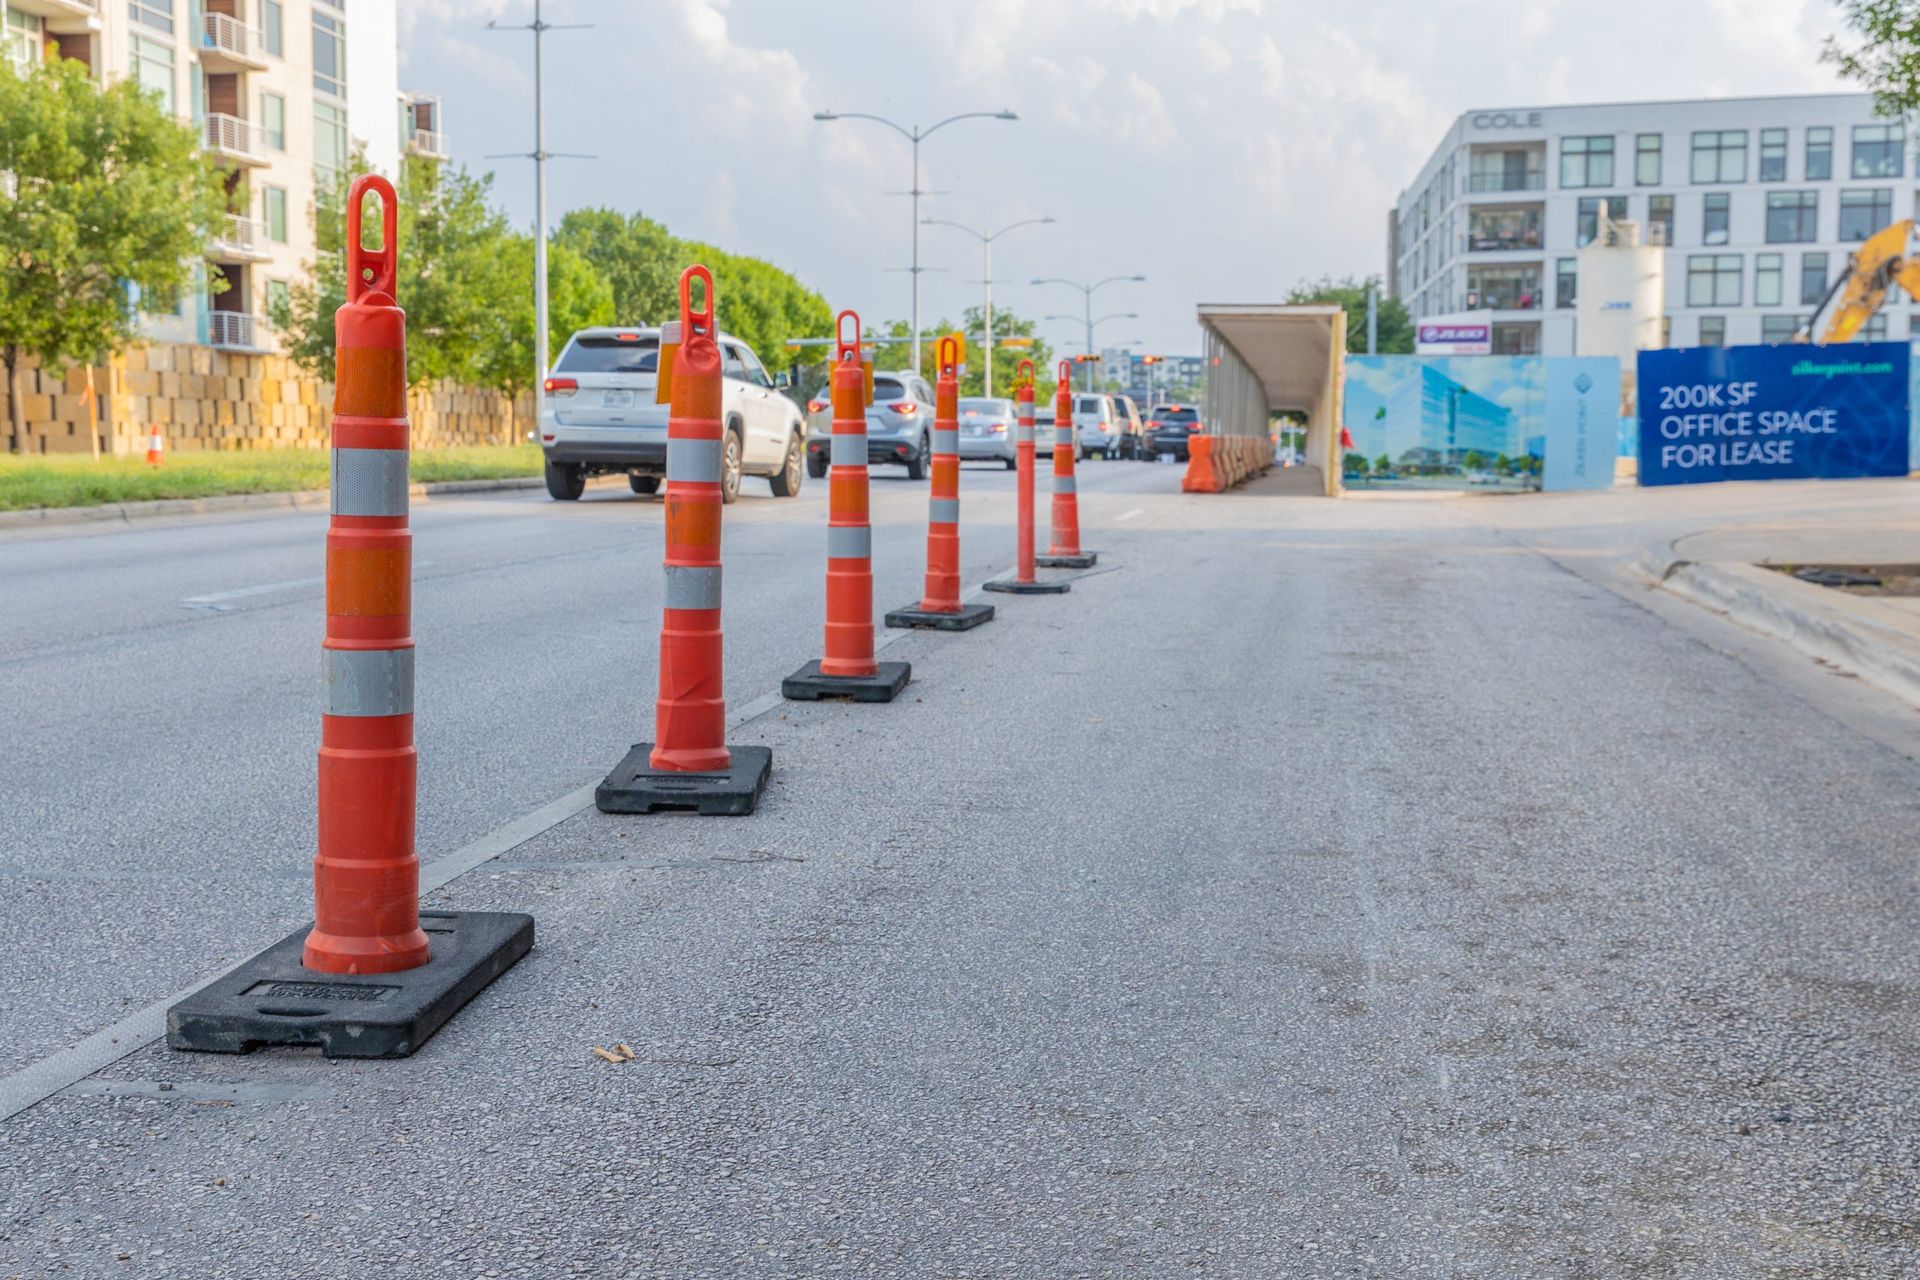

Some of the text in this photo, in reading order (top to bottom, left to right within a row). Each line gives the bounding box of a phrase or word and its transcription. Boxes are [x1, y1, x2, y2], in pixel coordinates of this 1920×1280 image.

[1473, 112, 1543, 130] COLE
[1659, 381, 1759, 410] 200K SF
[1660, 409, 1837, 439] OFFICE SPACE
[1661, 440, 1795, 469] FOR LEASE
